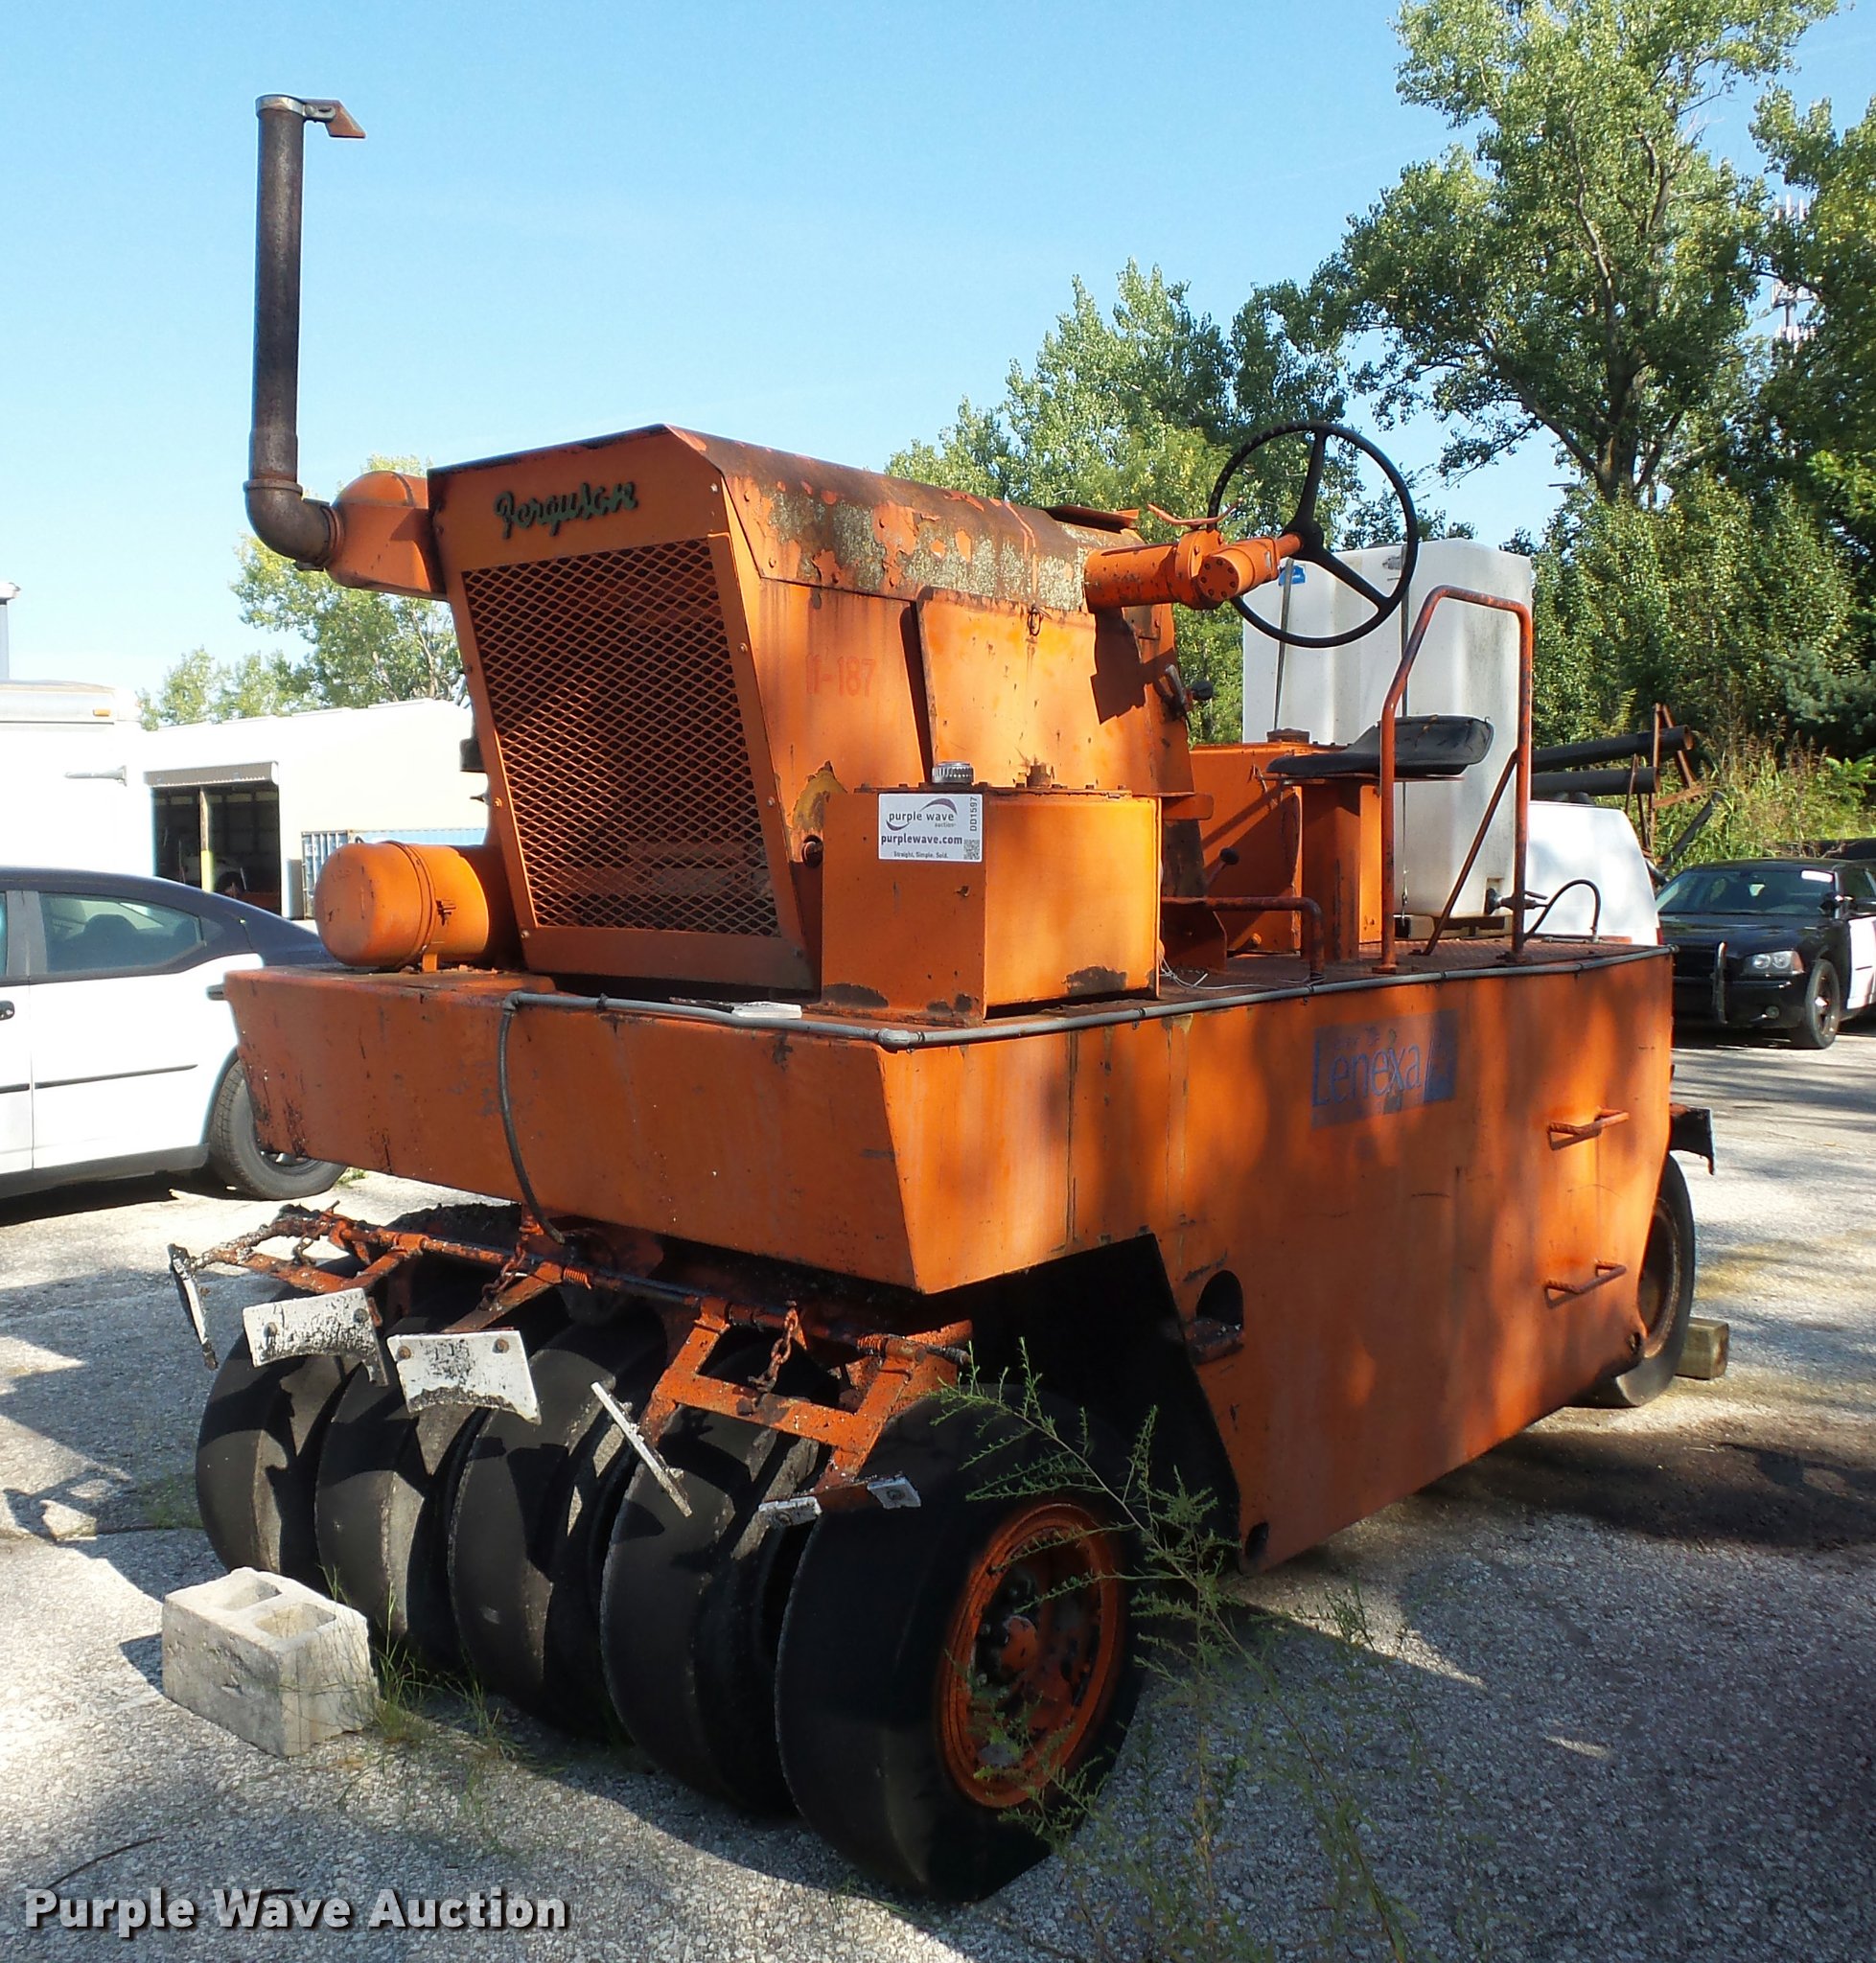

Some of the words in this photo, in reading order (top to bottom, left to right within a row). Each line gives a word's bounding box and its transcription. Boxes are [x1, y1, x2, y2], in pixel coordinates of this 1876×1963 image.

[495, 481, 639, 540] Ferguson
[889, 811, 922, 822] purple
[926, 813, 955, 821] wave
[969, 797, 978, 831] DD1597
[881, 833, 962, 845] purplewave.com
[1311, 1040, 1422, 1107] Lenexa
